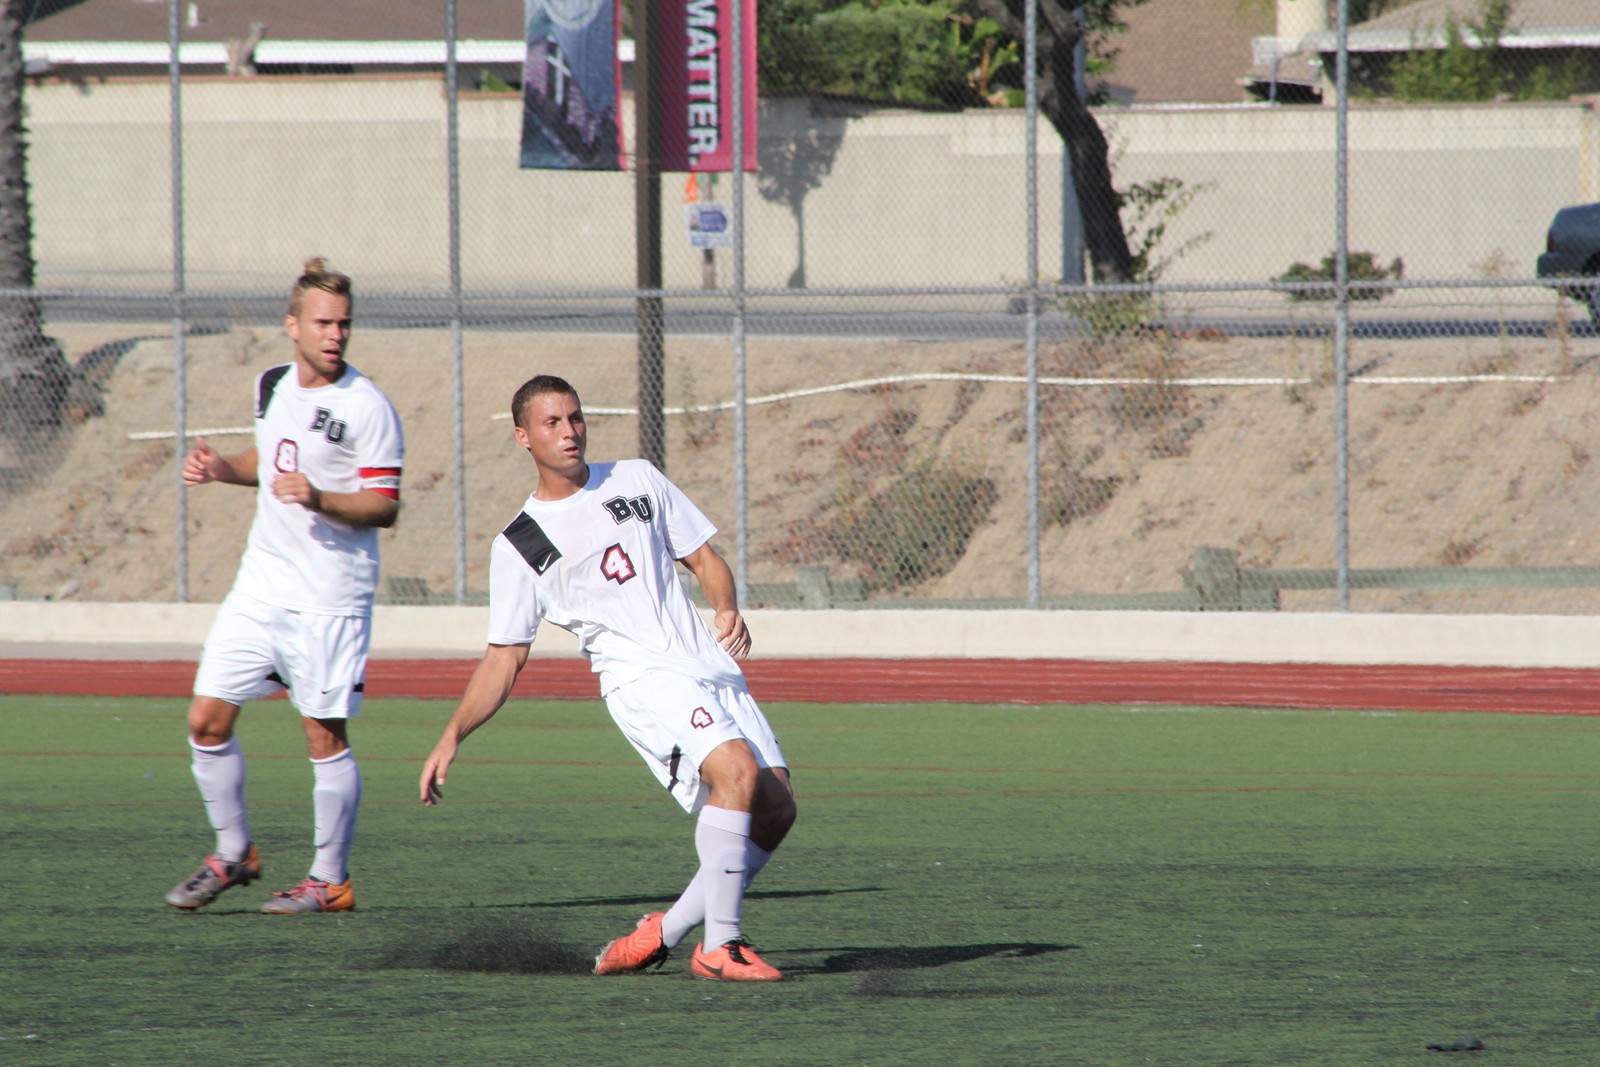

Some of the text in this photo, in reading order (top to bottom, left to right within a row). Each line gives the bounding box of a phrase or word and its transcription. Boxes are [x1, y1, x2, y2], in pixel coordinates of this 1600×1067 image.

[308, 406, 348, 445] BU
[601, 495, 655, 526] BU
[600, 542, 637, 586] 4
[690, 706, 714, 729] 4
